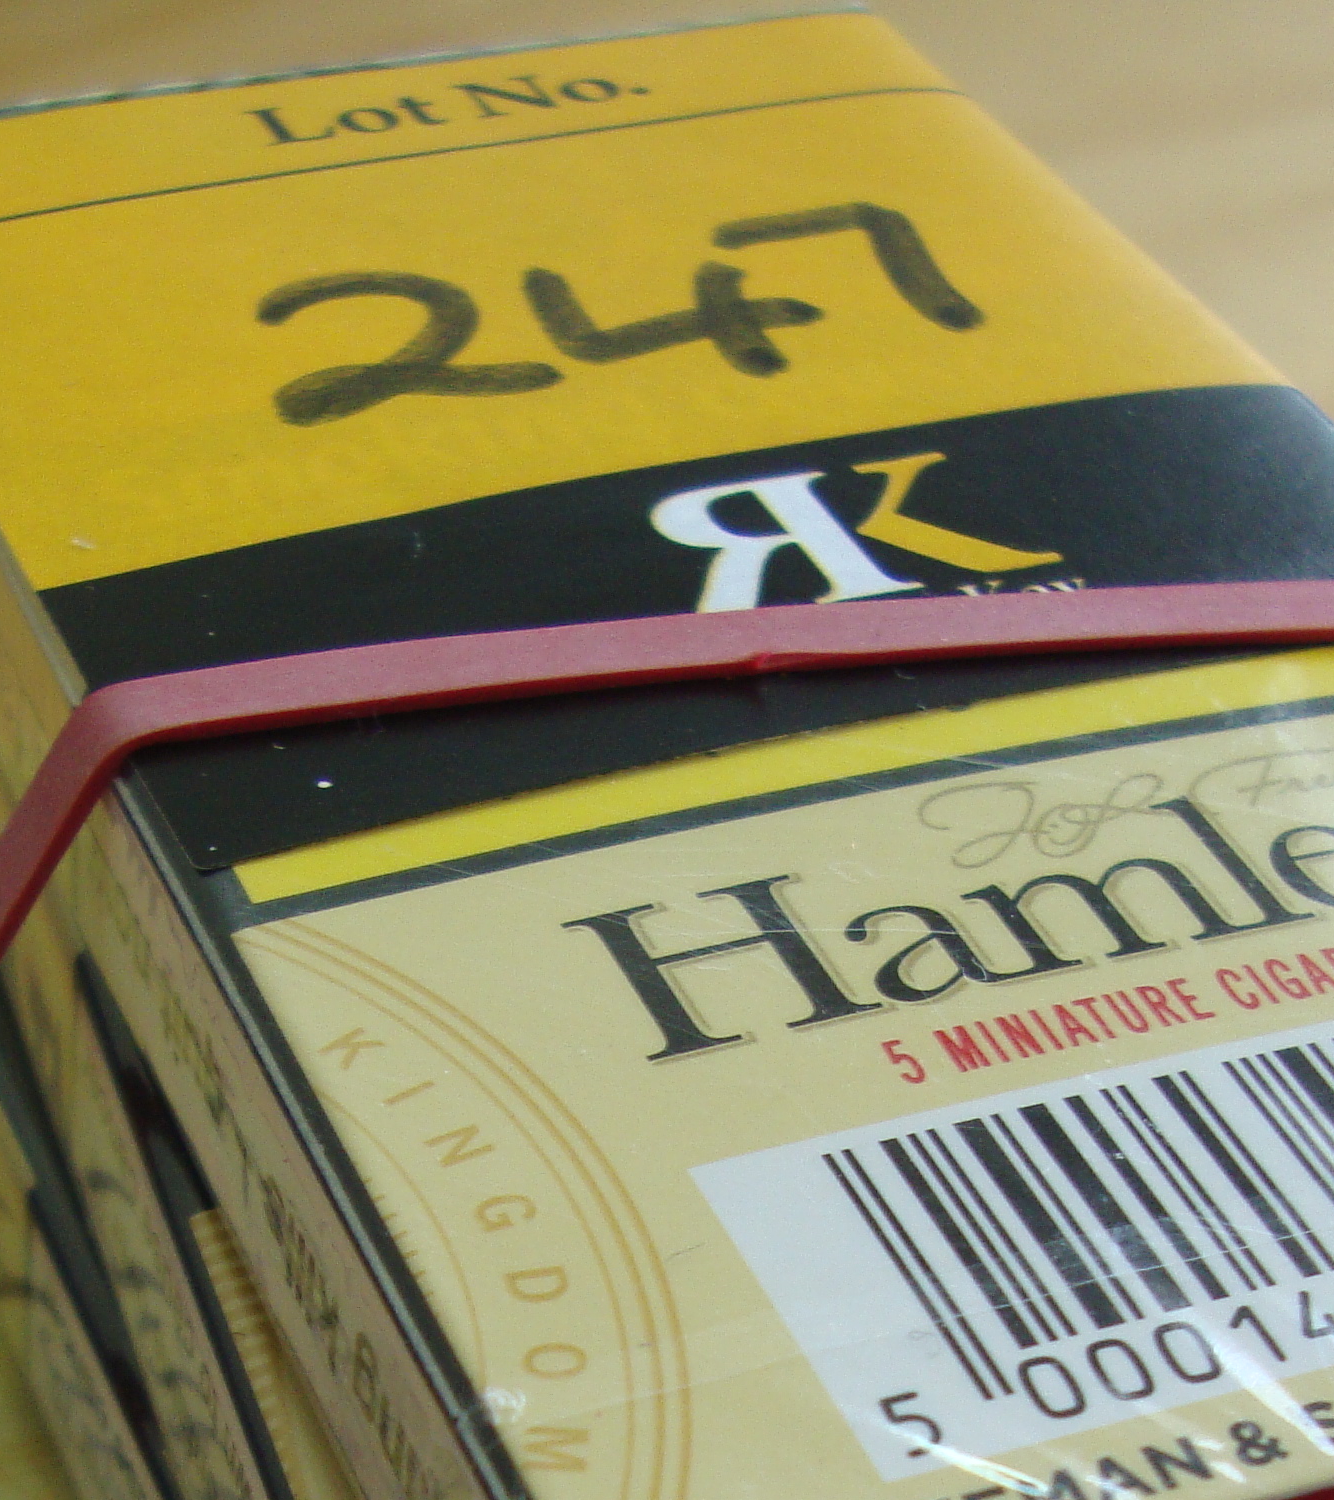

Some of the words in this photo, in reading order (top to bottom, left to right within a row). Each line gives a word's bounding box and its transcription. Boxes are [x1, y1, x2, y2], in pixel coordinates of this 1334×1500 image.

[245, 91, 447, 149] Lot
[466, 66, 650, 121] No.
[255, 202, 986, 427] 247
[883, 1039, 928, 1085] 5
[935, 961, 1215, 1081] MINIATURE
[317, 1025, 592, 1478] KINGDOM
[878, 1392, 944, 1460] 5
[1232, 1416, 1296, 1468] &
